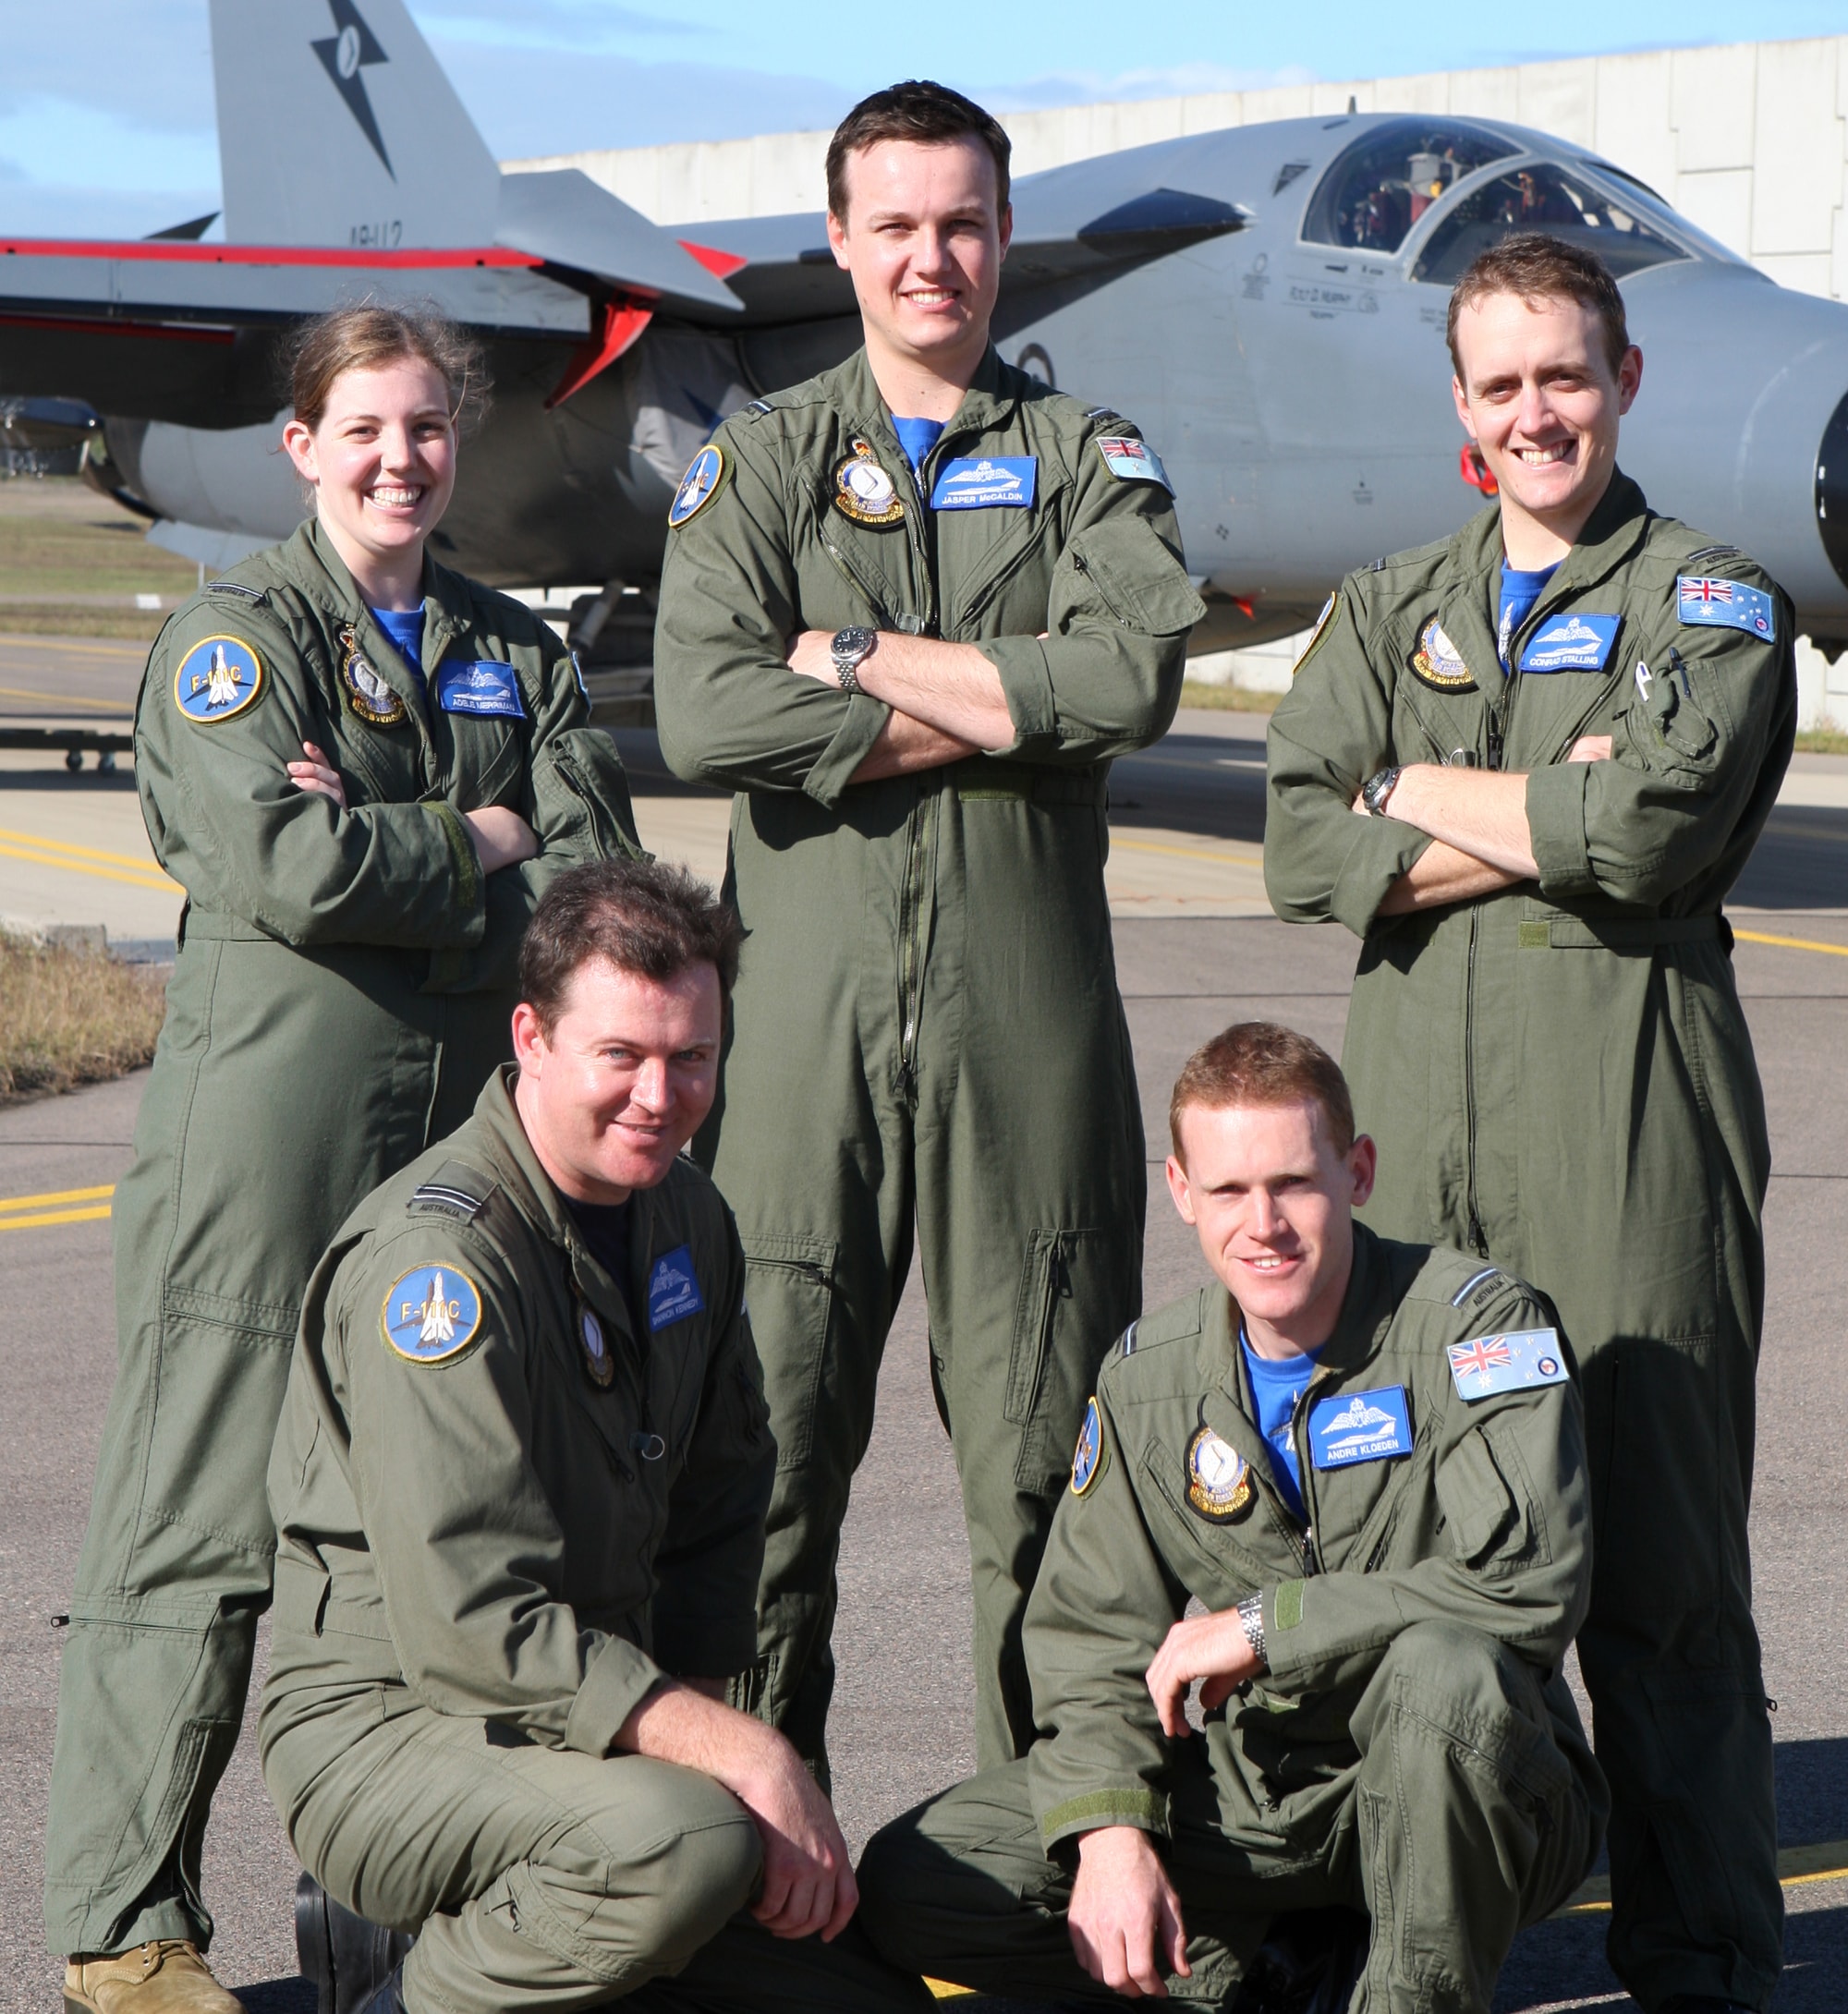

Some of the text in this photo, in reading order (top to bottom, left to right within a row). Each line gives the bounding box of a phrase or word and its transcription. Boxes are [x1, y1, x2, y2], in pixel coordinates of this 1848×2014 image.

[942, 492, 1023, 504] JASPER McCALDIN
[1562, 655, 1599, 665] STALLING
[190, 665, 242, 693] F-111C
[453, 698, 476, 709] ADELE
[419, 1203, 461, 1219] AUSTRALIA
[1472, 1279, 1505, 1307] AUSTRALIA
[400, 1300, 461, 1322] F-111C
[1327, 1438, 1399, 1461] ANDRE KLOEDEN
